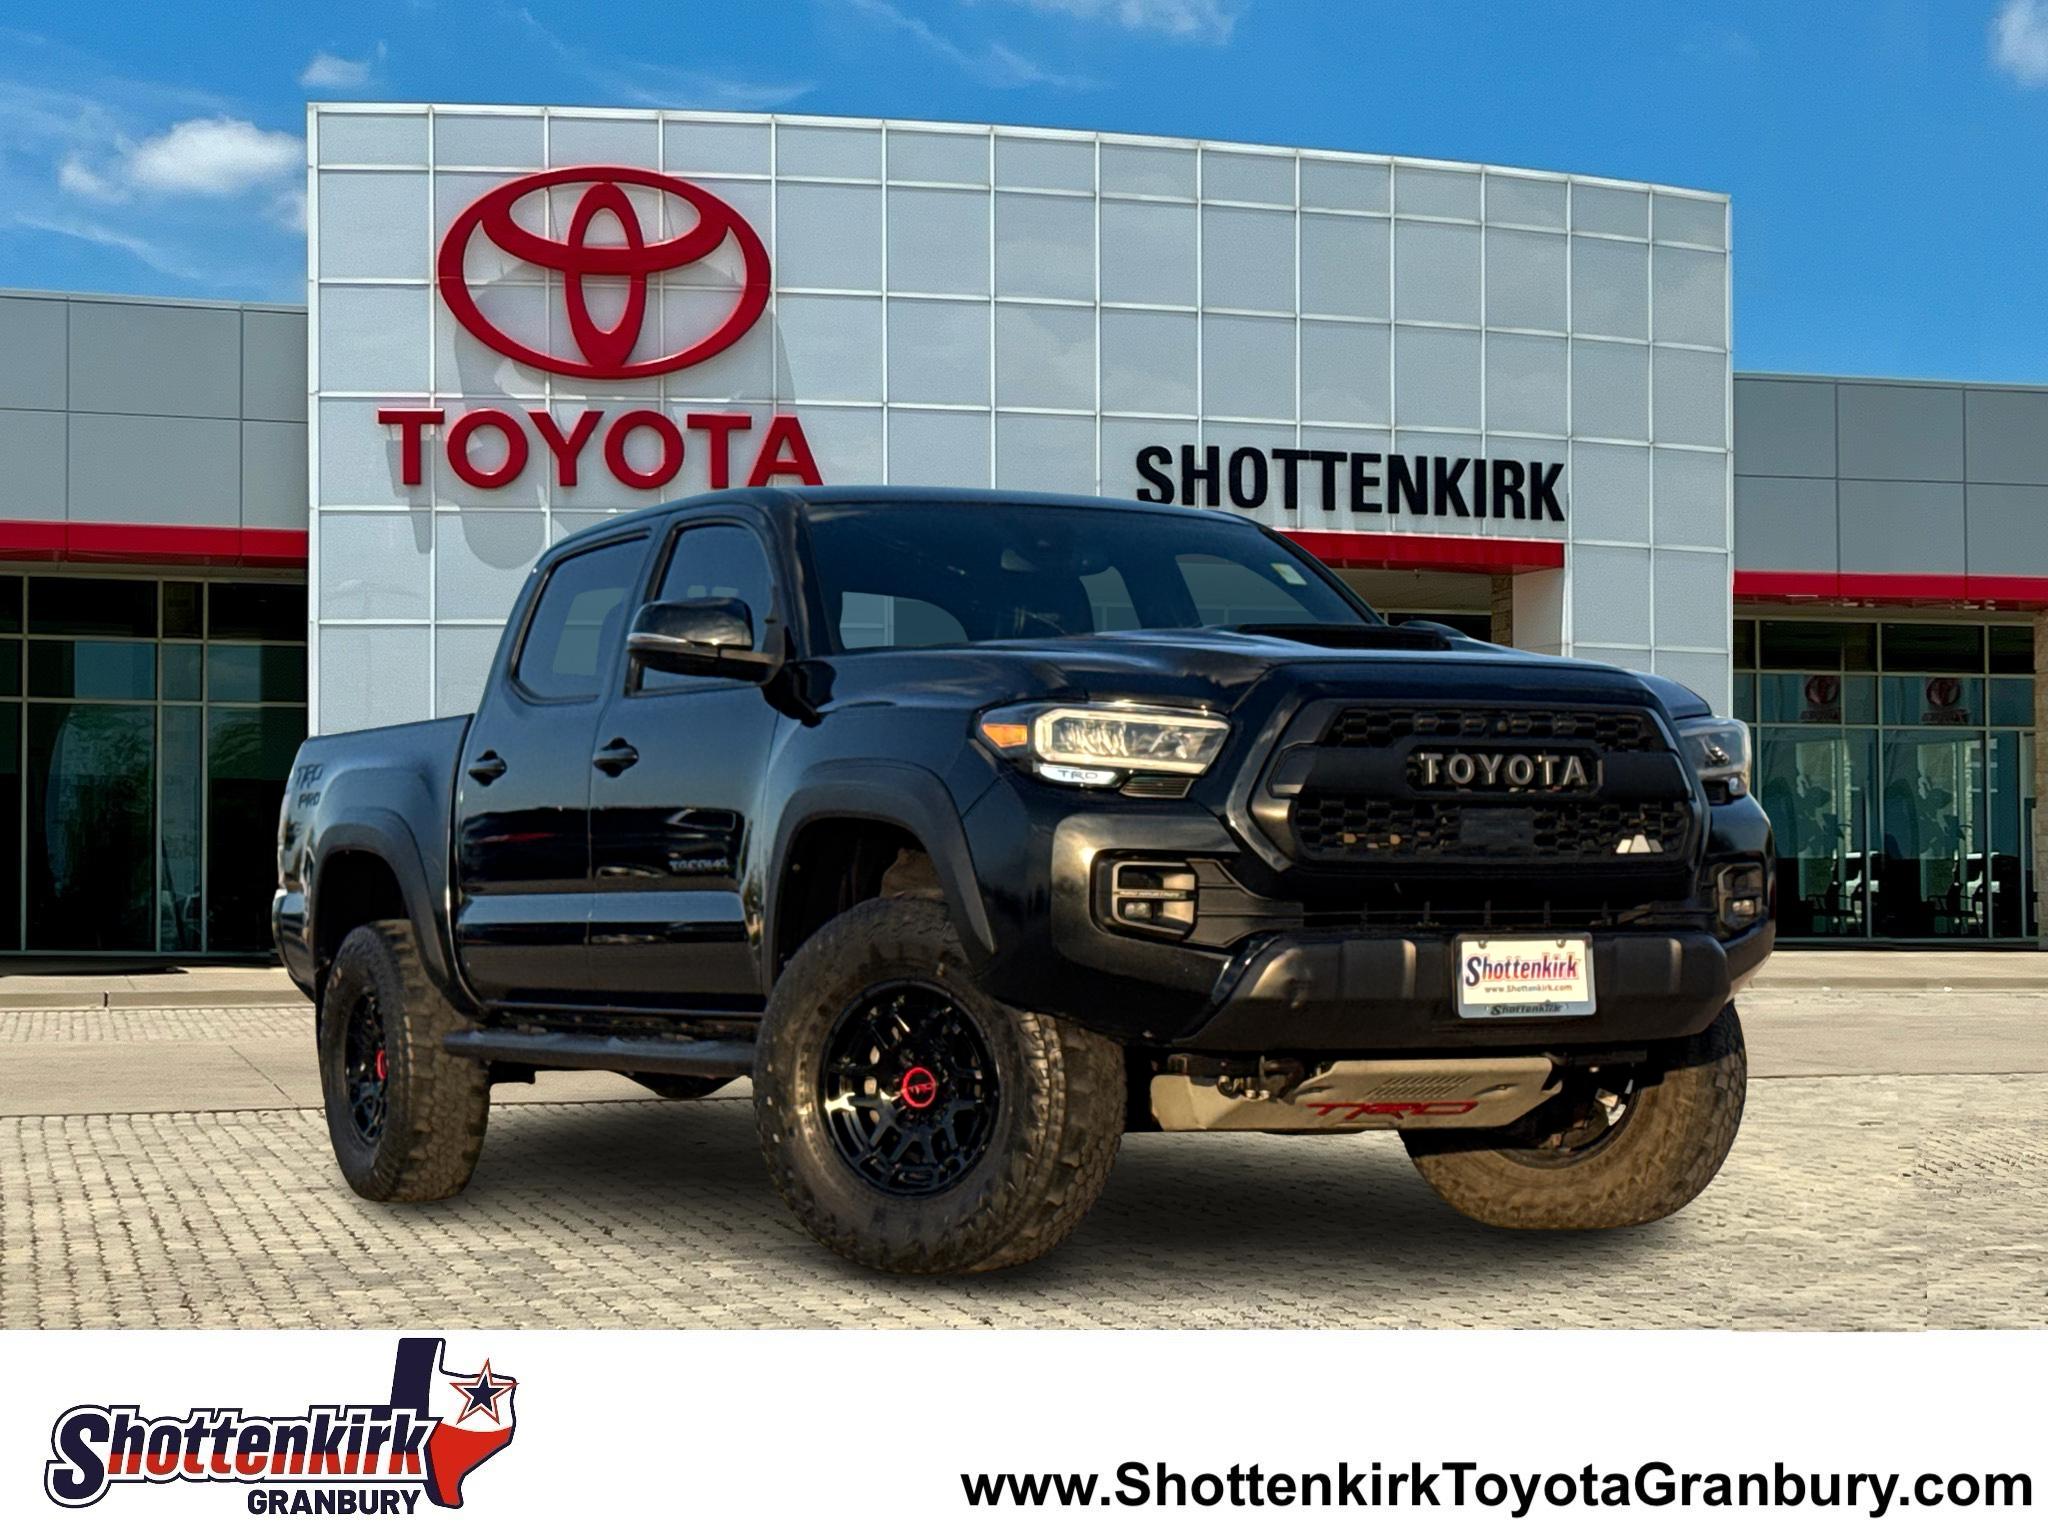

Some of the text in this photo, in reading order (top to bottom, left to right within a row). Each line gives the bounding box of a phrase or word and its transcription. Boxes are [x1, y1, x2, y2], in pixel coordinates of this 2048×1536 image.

[378, 407, 824, 488] TOYOTA
[1136, 445, 1565, 522] SHOTTENKIRK
[295, 763, 324, 789] TRD
[1057, 769, 1099, 780] TRD
[1420, 752, 1588, 786] TOYOTA
[297, 791, 321, 809] PRO
[1465, 954, 1578, 987] Shottenkirk
[1306, 1101, 1479, 1120] TRD
